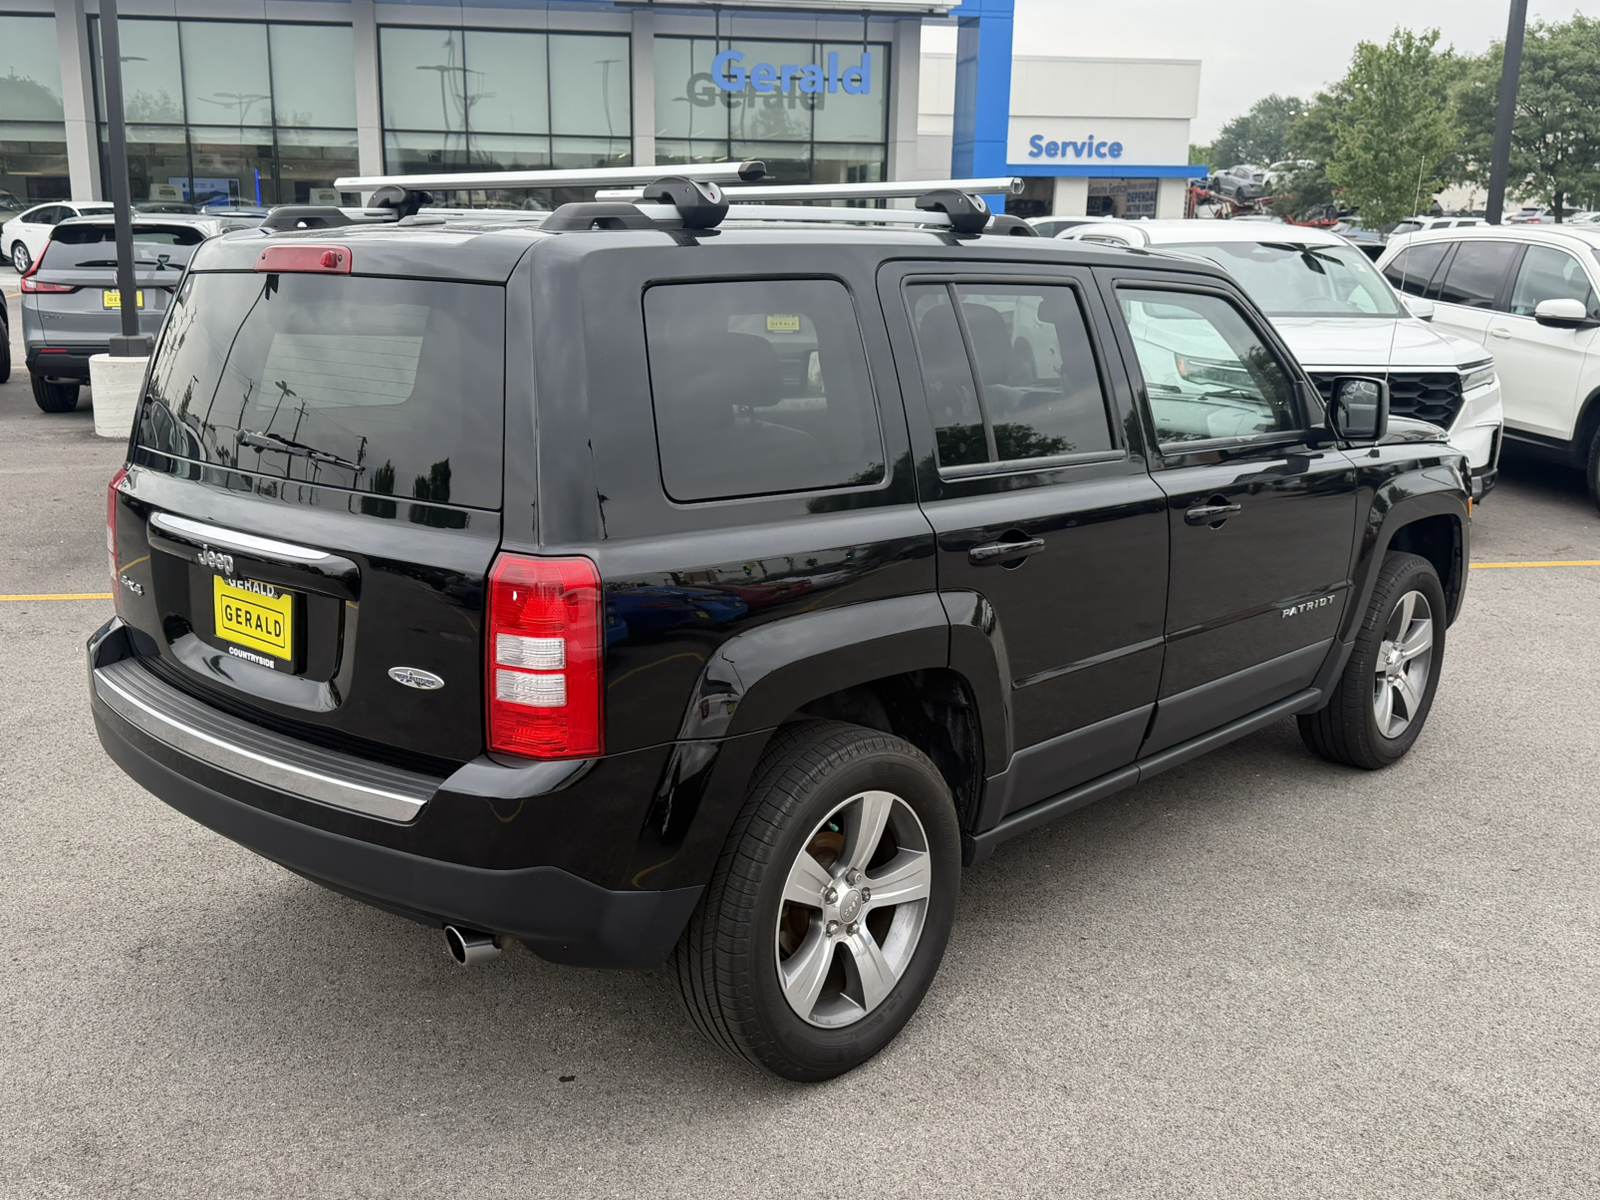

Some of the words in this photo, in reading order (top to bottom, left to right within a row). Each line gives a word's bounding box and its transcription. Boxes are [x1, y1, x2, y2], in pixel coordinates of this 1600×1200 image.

[711, 50, 871, 95] Gerald
[1028, 134, 1123, 159] Service
[1109, 182, 1127, 194] Service
[1142, 204, 1154, 212] FIRST
[197, 543, 234, 576] Jeep
[228, 577, 275, 598] GERALD
[1281, 594, 1336, 619] PATRIOT
[224, 603, 282, 638] GERALD
[228, 646, 275, 669] COUNTRYSIDE
